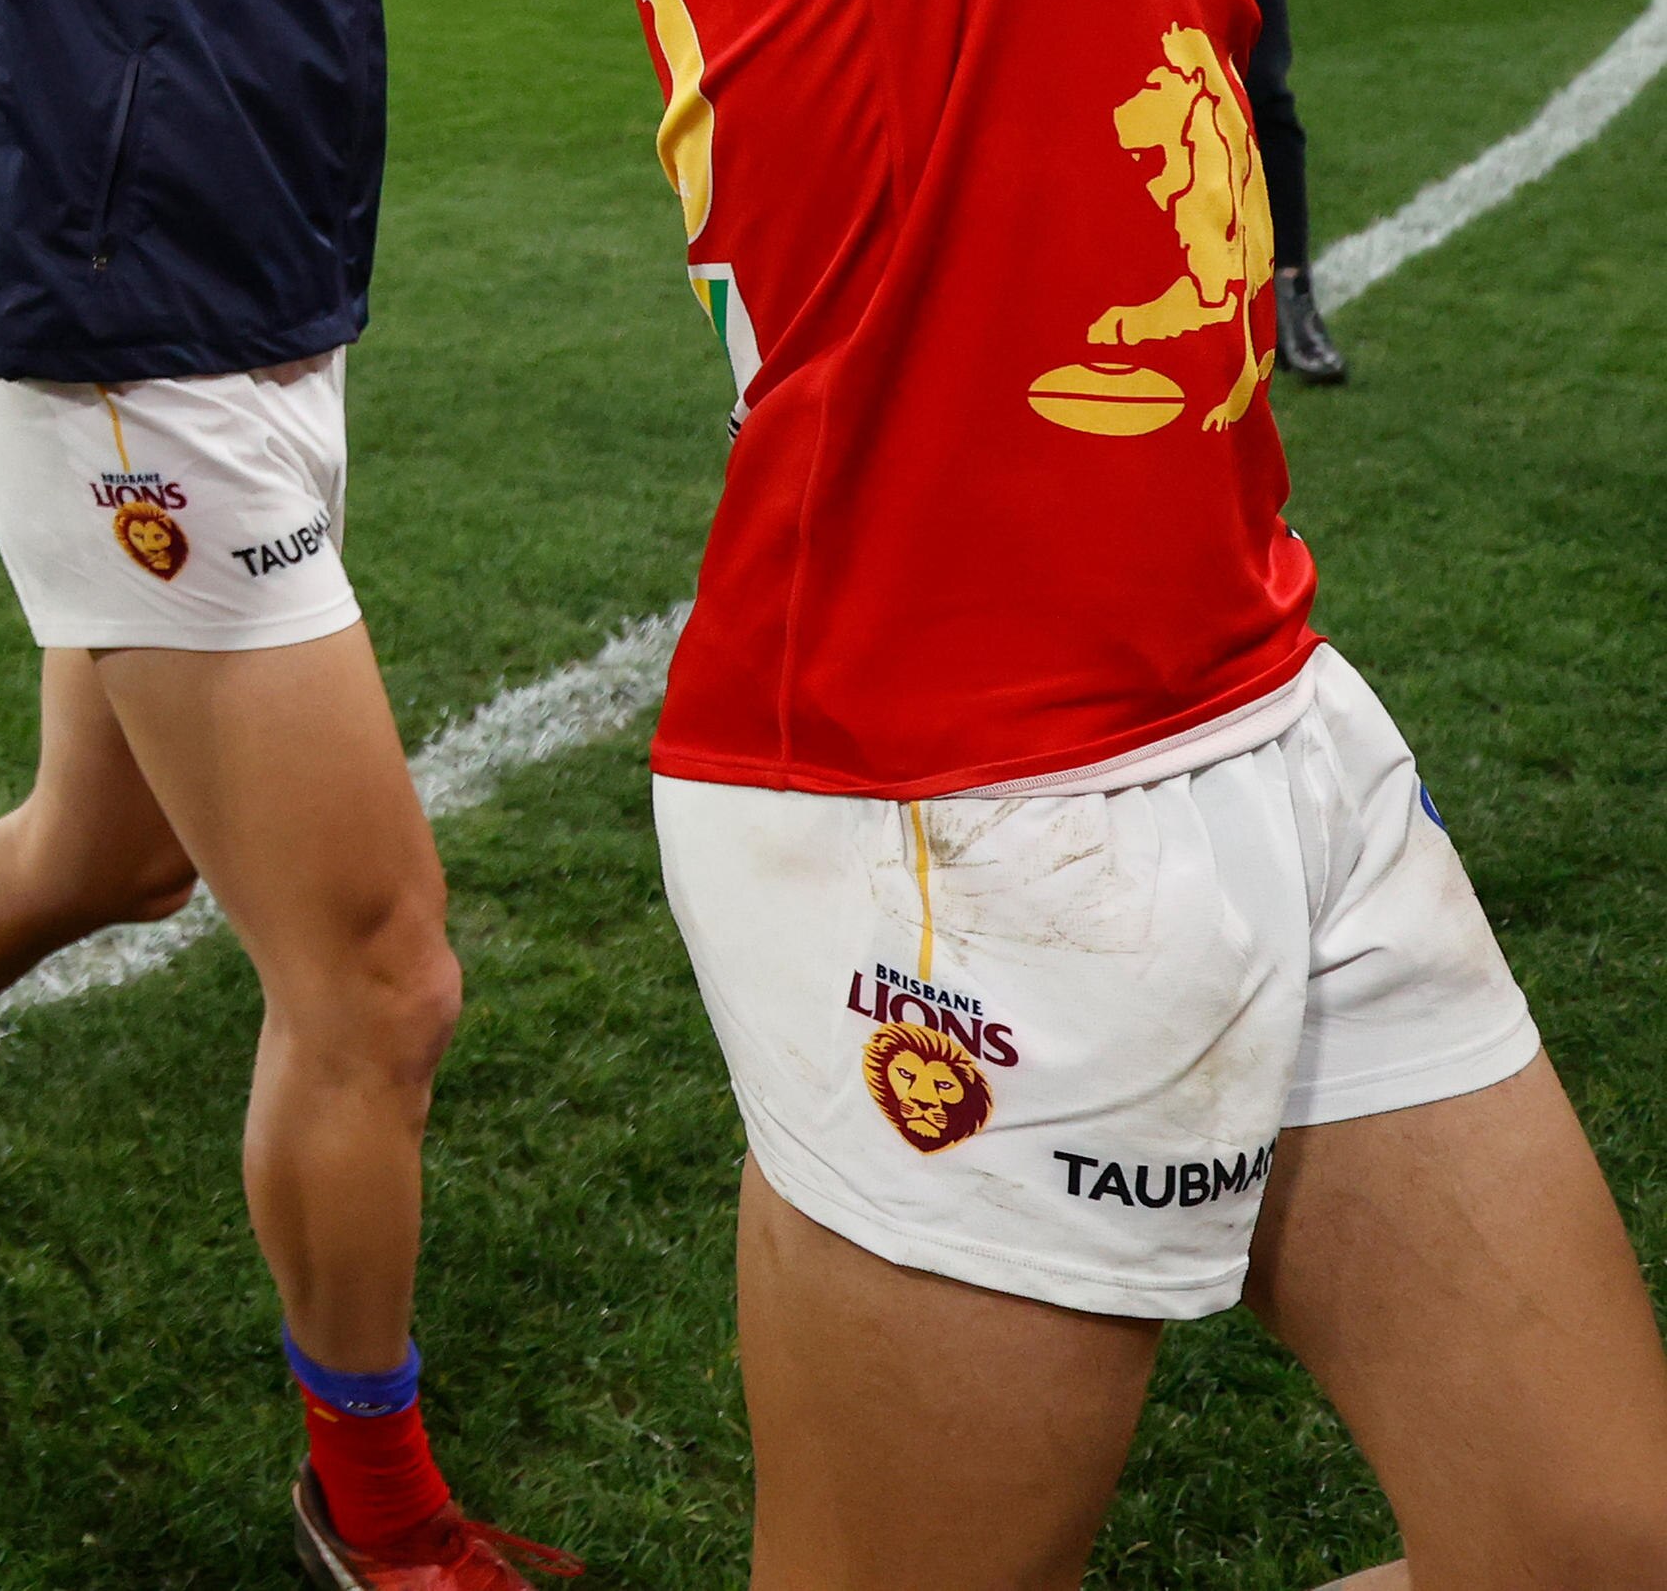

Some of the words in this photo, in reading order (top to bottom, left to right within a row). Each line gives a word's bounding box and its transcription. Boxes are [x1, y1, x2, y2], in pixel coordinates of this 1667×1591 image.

[89, 482, 188, 511] LIONS
[875, 962, 984, 1017] BRISBANE
[847, 969, 1019, 1068] LIONS
